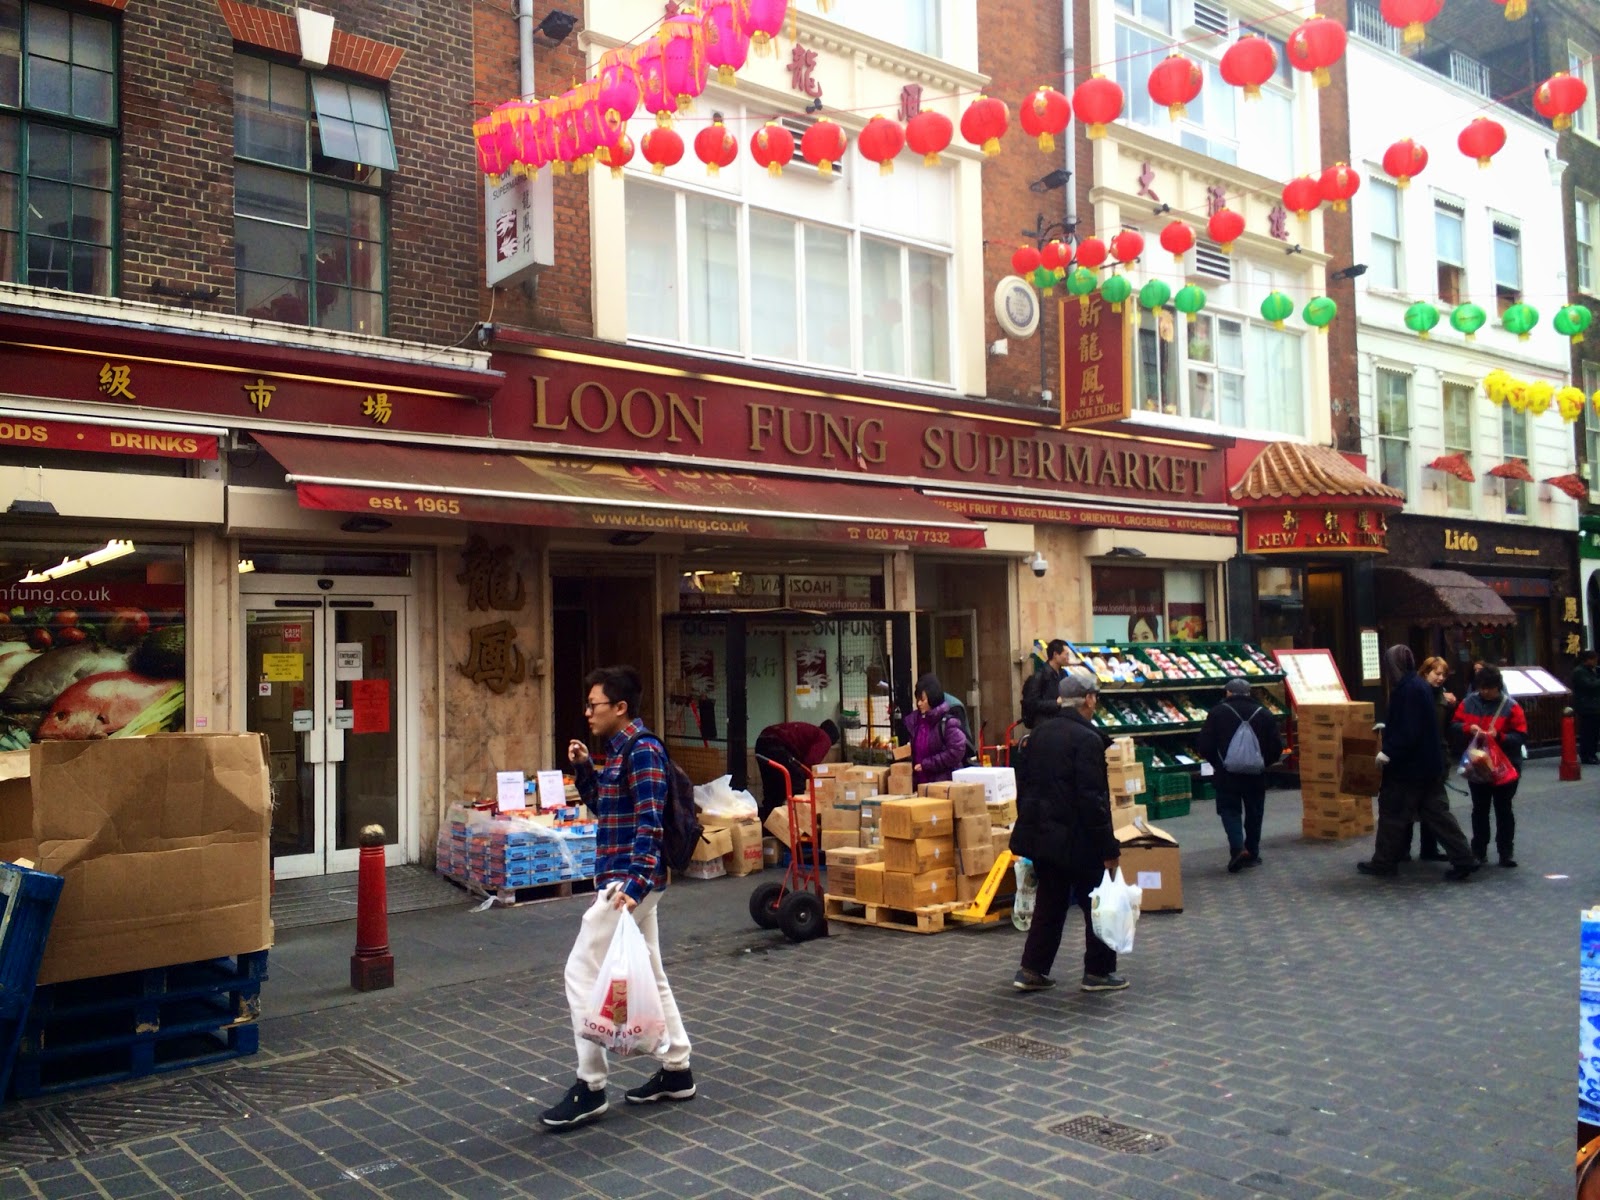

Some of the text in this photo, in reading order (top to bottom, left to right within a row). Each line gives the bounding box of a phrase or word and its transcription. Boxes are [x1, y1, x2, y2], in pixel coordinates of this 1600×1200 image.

[1078, 298, 1105, 394] 新龍鳳
[1079, 394, 1105, 407] NEW
[1066, 402, 1121, 420] LOON FUNG
[0, 423, 198, 453] ODS DRINKS
[532, 375, 1208, 496] LOON FUNG SUPERMARKET
[369, 496, 460, 514] est. 1965
[592, 513, 750, 533] www.loonfung.co.uk
[969, 503, 998, 515] FRUIT
[1001, 504, 1009, 515] &
[1011, 506, 1071, 520] VEGETABLES
[1079, 512, 1122, 525] ORIENTAL
[1123, 515, 1170, 528] GROCERIES
[1176, 519, 1233, 532] KITCHENWARE
[867, 528, 950, 544] 020 7437 7332
[1258, 532, 1298, 547] NEW
[1445, 529, 1478, 551] Lido
[0, 583, 111, 604] nfung.co.uk
